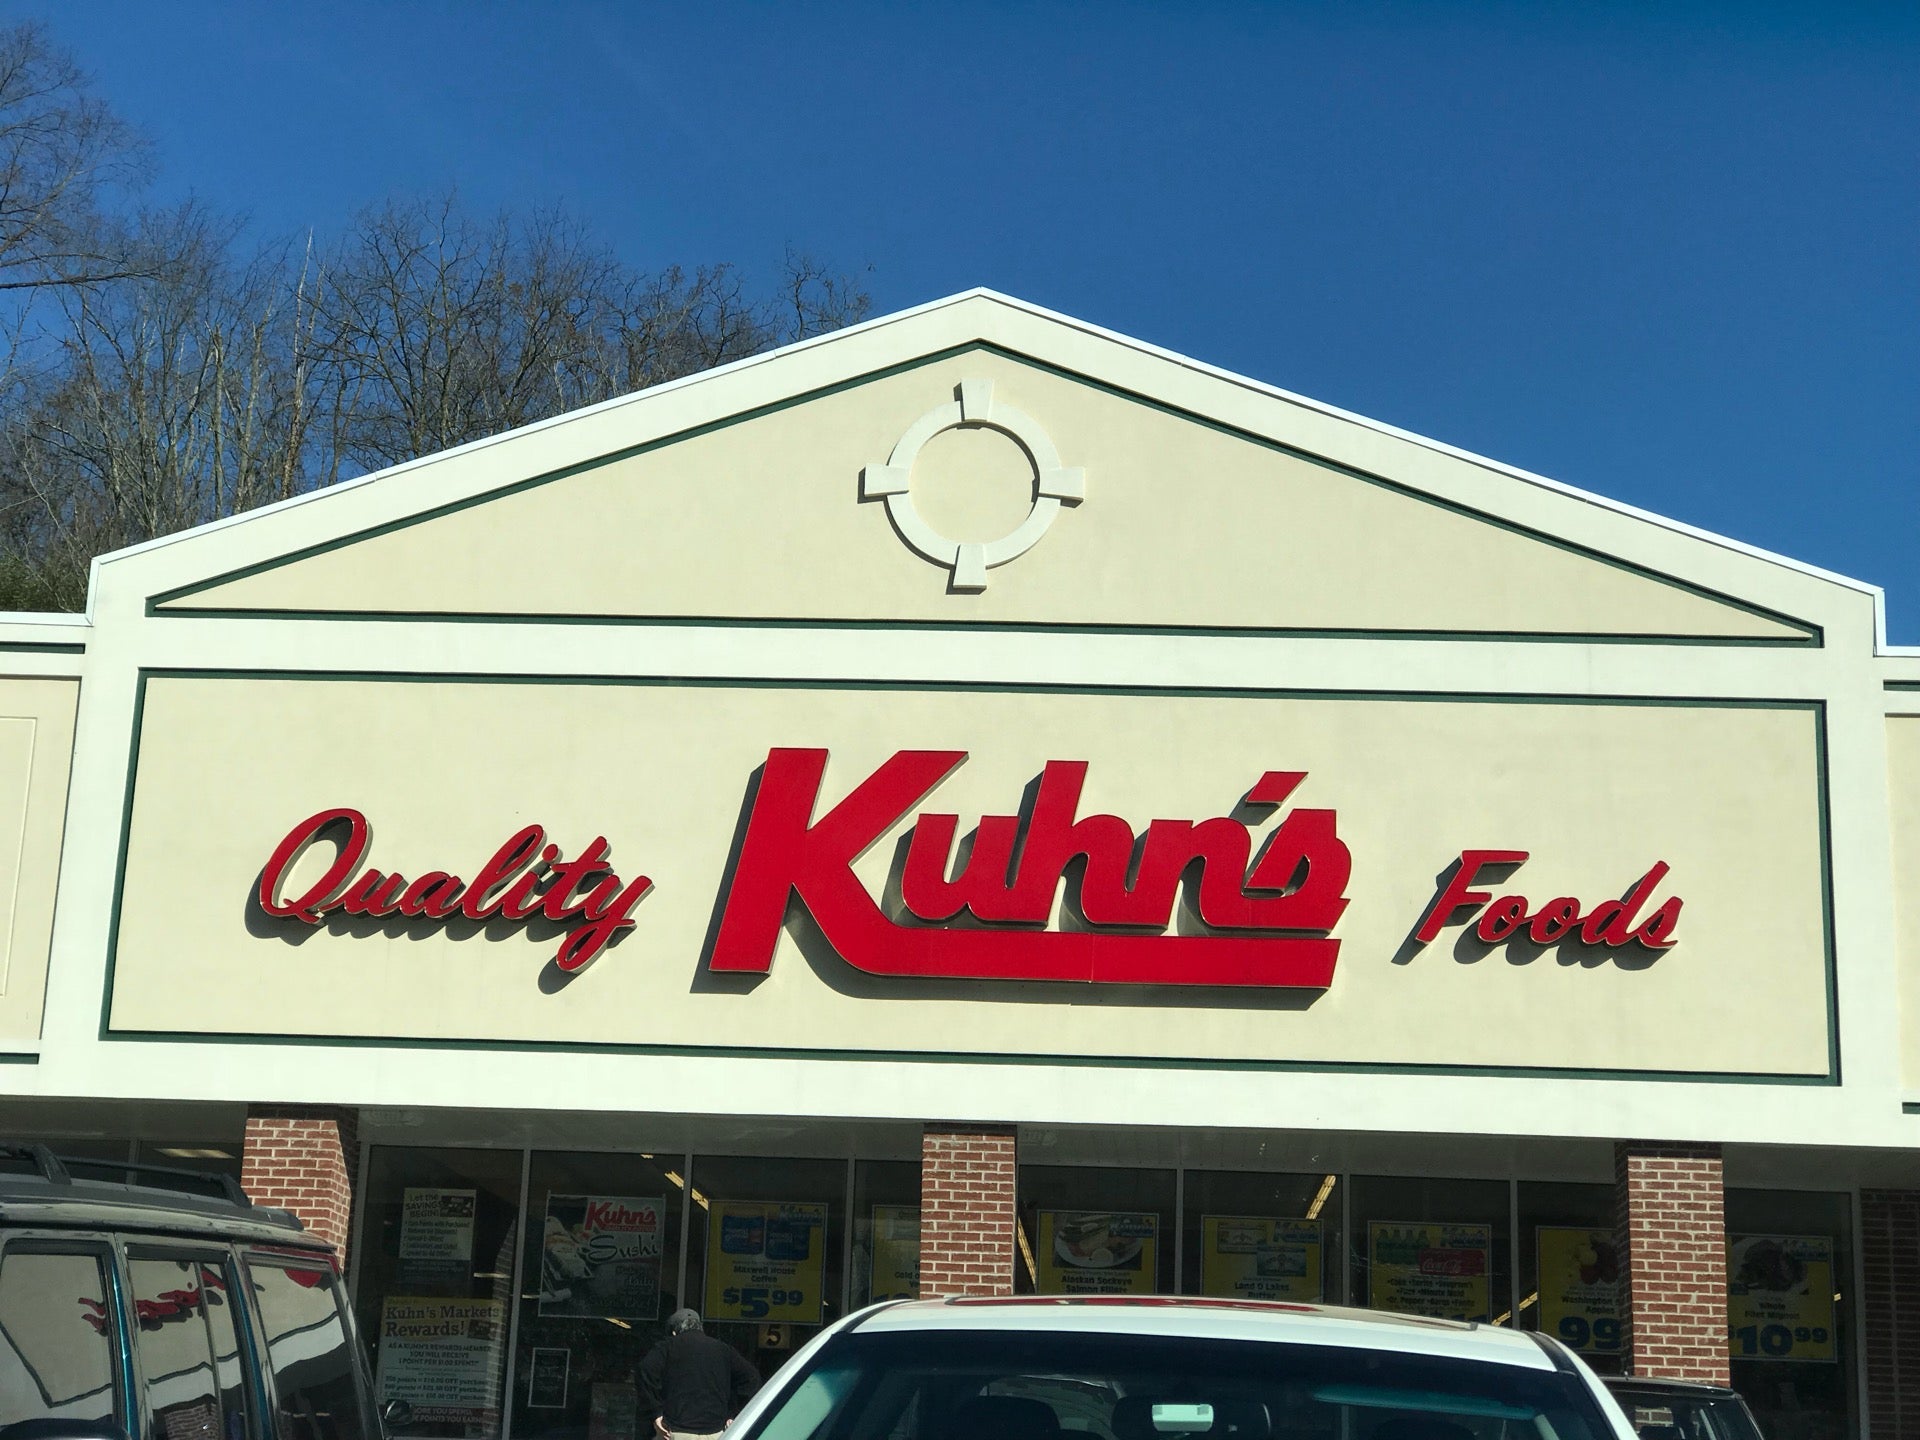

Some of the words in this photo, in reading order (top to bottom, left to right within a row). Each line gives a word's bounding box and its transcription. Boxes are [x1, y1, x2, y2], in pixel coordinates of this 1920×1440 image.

[259, 807, 654, 974] Quality
[710, 747, 1352, 989] Kuhn's
[1417, 849, 1684, 950] Foods
[585, 1201, 656, 1232] Kuhn's
[588, 1235, 658, 1262] Sushi
[733, 1265, 768, 1274] Maxwell
[770, 1266, 796, 1275] House
[751, 1275, 778, 1283] Coffee
[1061, 1275, 1095, 1283] Alaskan
[1098, 1276, 1133, 1285] Sockeye
[1065, 1284, 1098, 1293] Salmon
[1234, 1282, 1255, 1290] Land
[1257, 1282, 1264, 1290] O
[1266, 1283, 1290, 1291] Lakes
[1561, 1296, 1613, 1304] Washington
[385, 1305, 437, 1319] Kuhn's
[440, 1305, 500, 1318] Markets
[1585, 1305, 1615, 1314] Apples
[385, 1320, 465, 1337] Rewards!
[766, 1324, 782, 1346] 5
